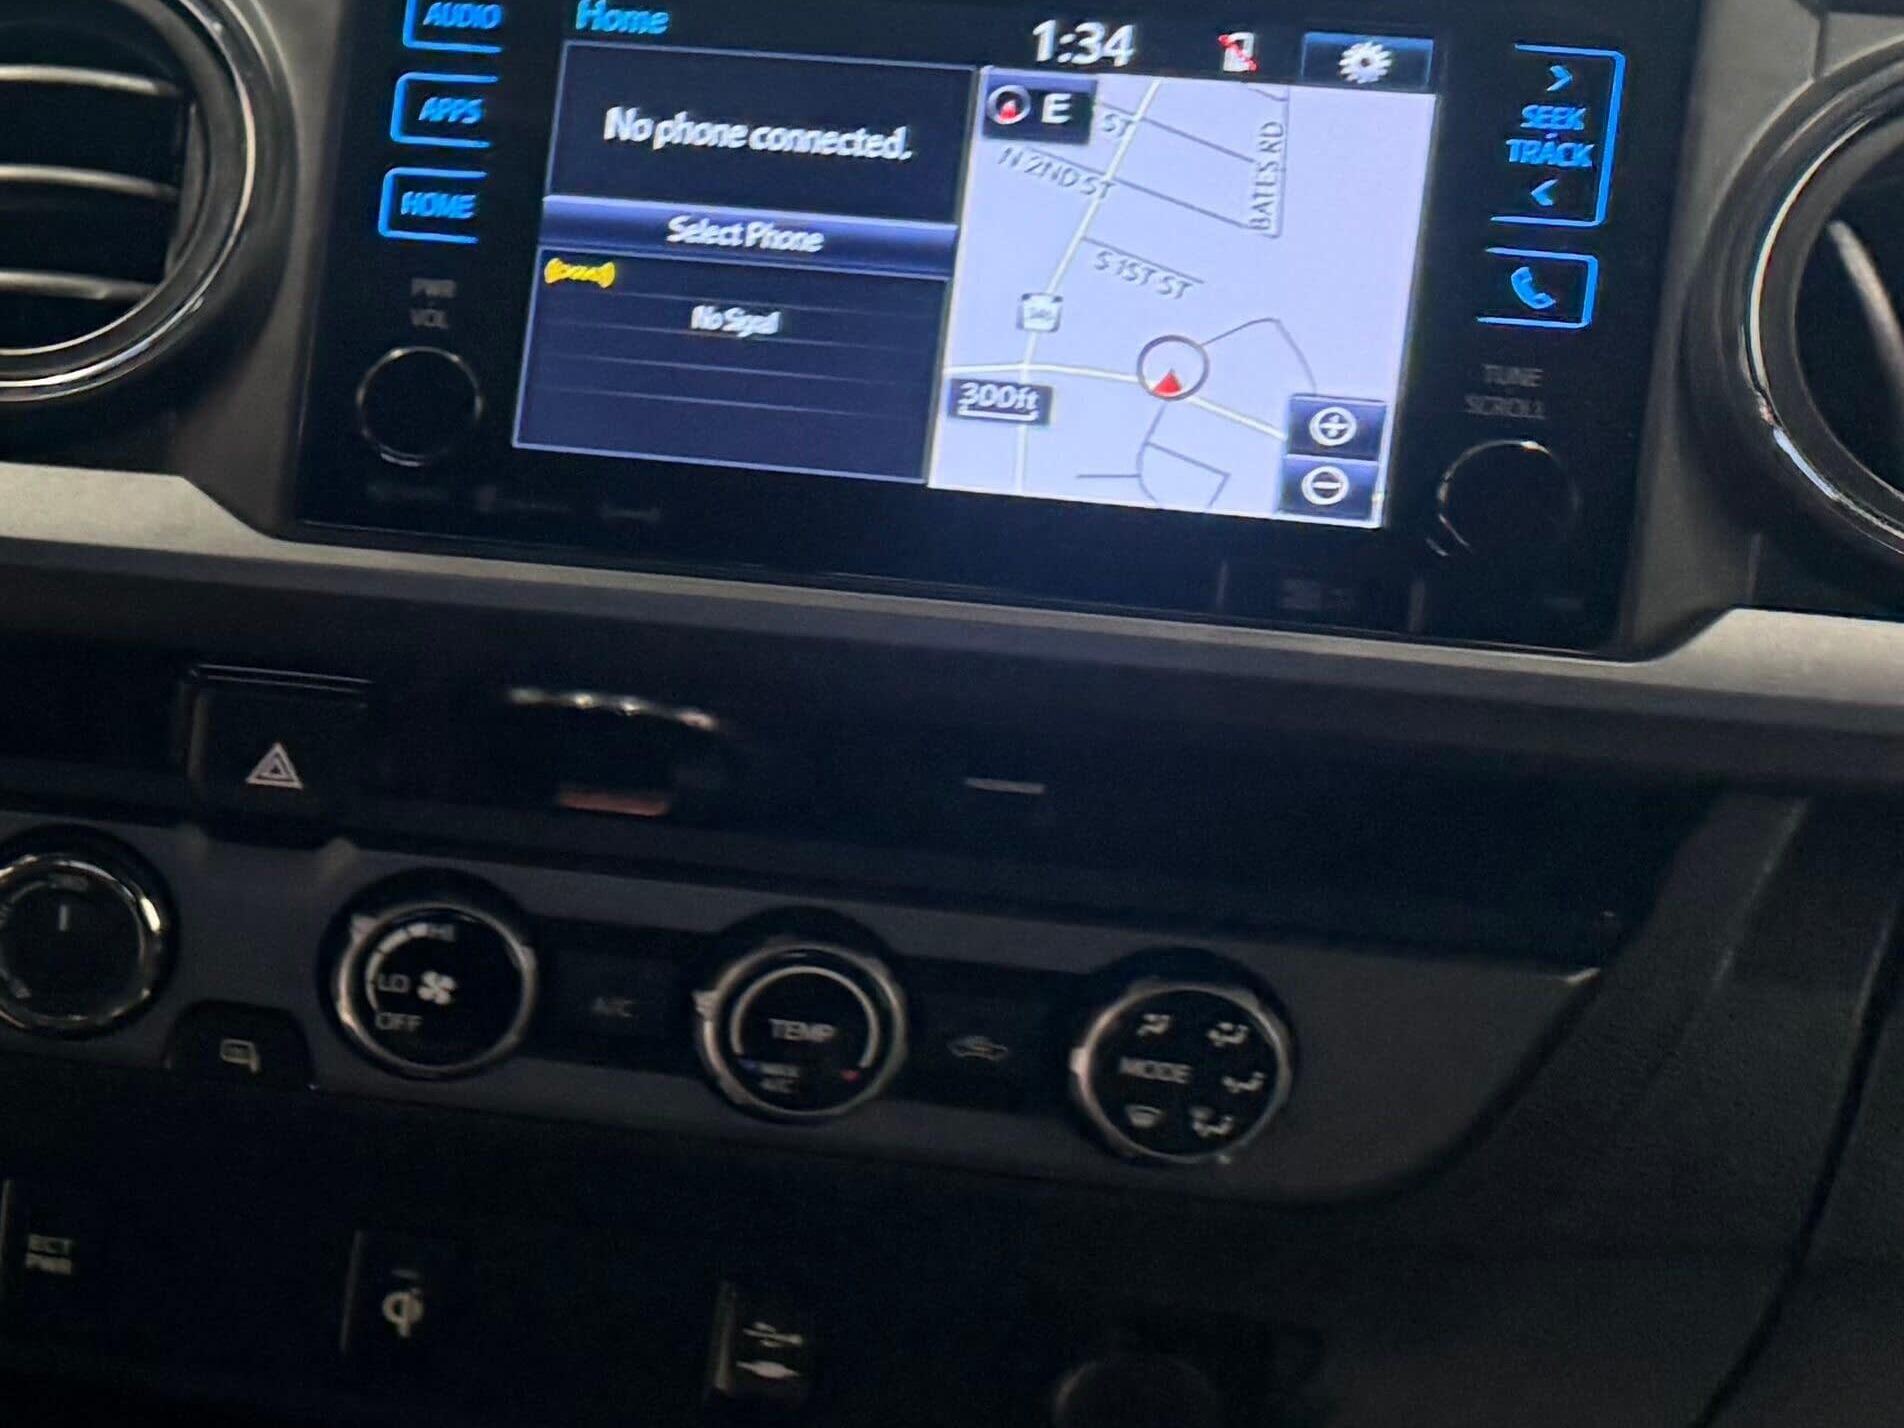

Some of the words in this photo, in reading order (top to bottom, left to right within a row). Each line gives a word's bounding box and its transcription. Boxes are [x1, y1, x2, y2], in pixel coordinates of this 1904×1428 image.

[423, 1, 502, 29] AUDIO
[1032, 19, 1136, 66] 1:34
[418, 96, 484, 124] APPS
[1042, 93, 1073, 124] E
[1520, 104, 1586, 130] SEEK
[603, 106, 652, 143] No
[653, 111, 747, 151] phone
[749, 125, 913, 161] connected.
[1258, 121, 1285, 155] RD
[1506, 139, 1595, 167] TRACK
[1023, 154, 1080, 188] 2ND
[1082, 179, 1116, 201] ST
[400, 191, 477, 219] HOME
[1247, 160, 1280, 232] BATES
[665, 215, 743, 247] Select
[745, 221, 825, 252] Phone
[1117, 257, 1158, 287] 1ST
[1159, 273, 1192, 300] ST
[691, 305, 723, 330] No
[958, 381, 1040, 411] 300ft
[379, 973, 411, 993] LO
[769, 1018, 837, 1043] TEMP
